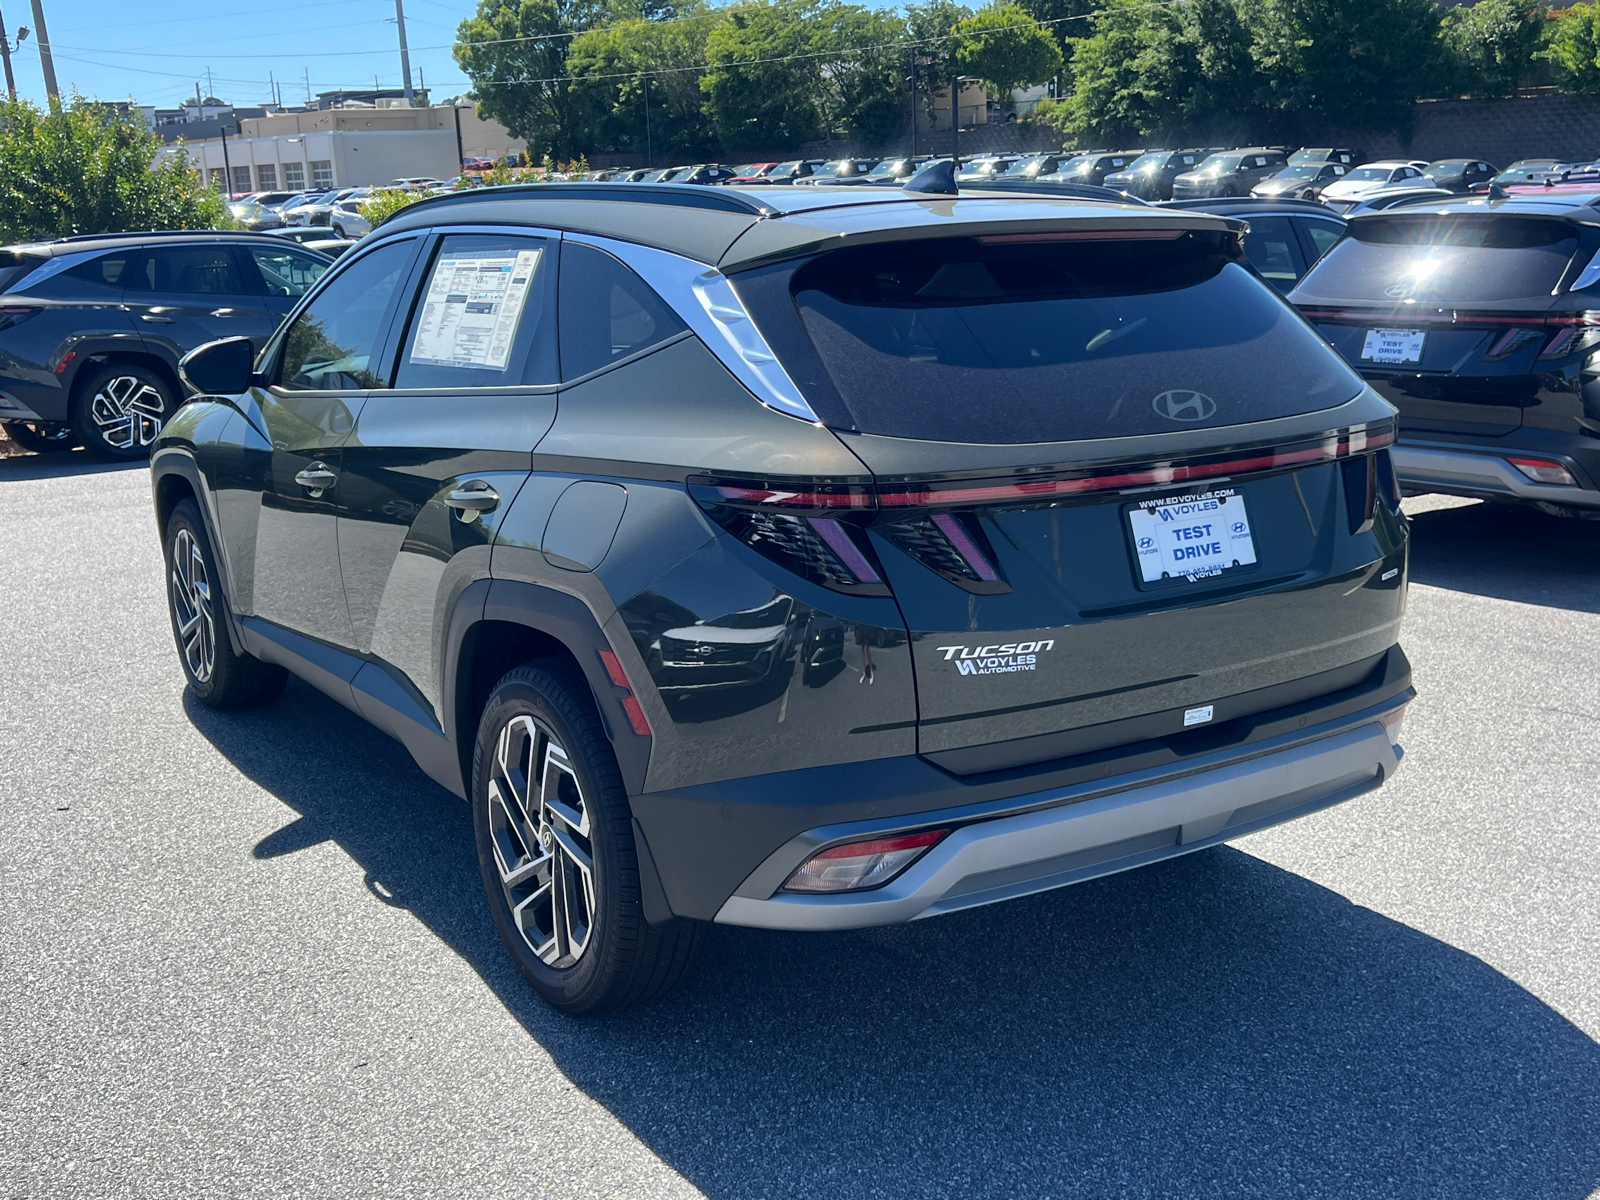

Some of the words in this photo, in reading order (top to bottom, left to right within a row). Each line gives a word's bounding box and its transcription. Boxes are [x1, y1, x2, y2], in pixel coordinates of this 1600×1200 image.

[1138, 488, 1235, 509] WWW.EDVOYLES.COM
[1172, 500, 1219, 516] VOYLES
[1172, 524, 1212, 541] TEST
[1172, 542, 1222, 561] DRIVE
[935, 639, 1055, 661] TUCSON
[976, 654, 1036, 668] VOYLES
[978, 664, 1036, 675] AUTOMOTIVE
